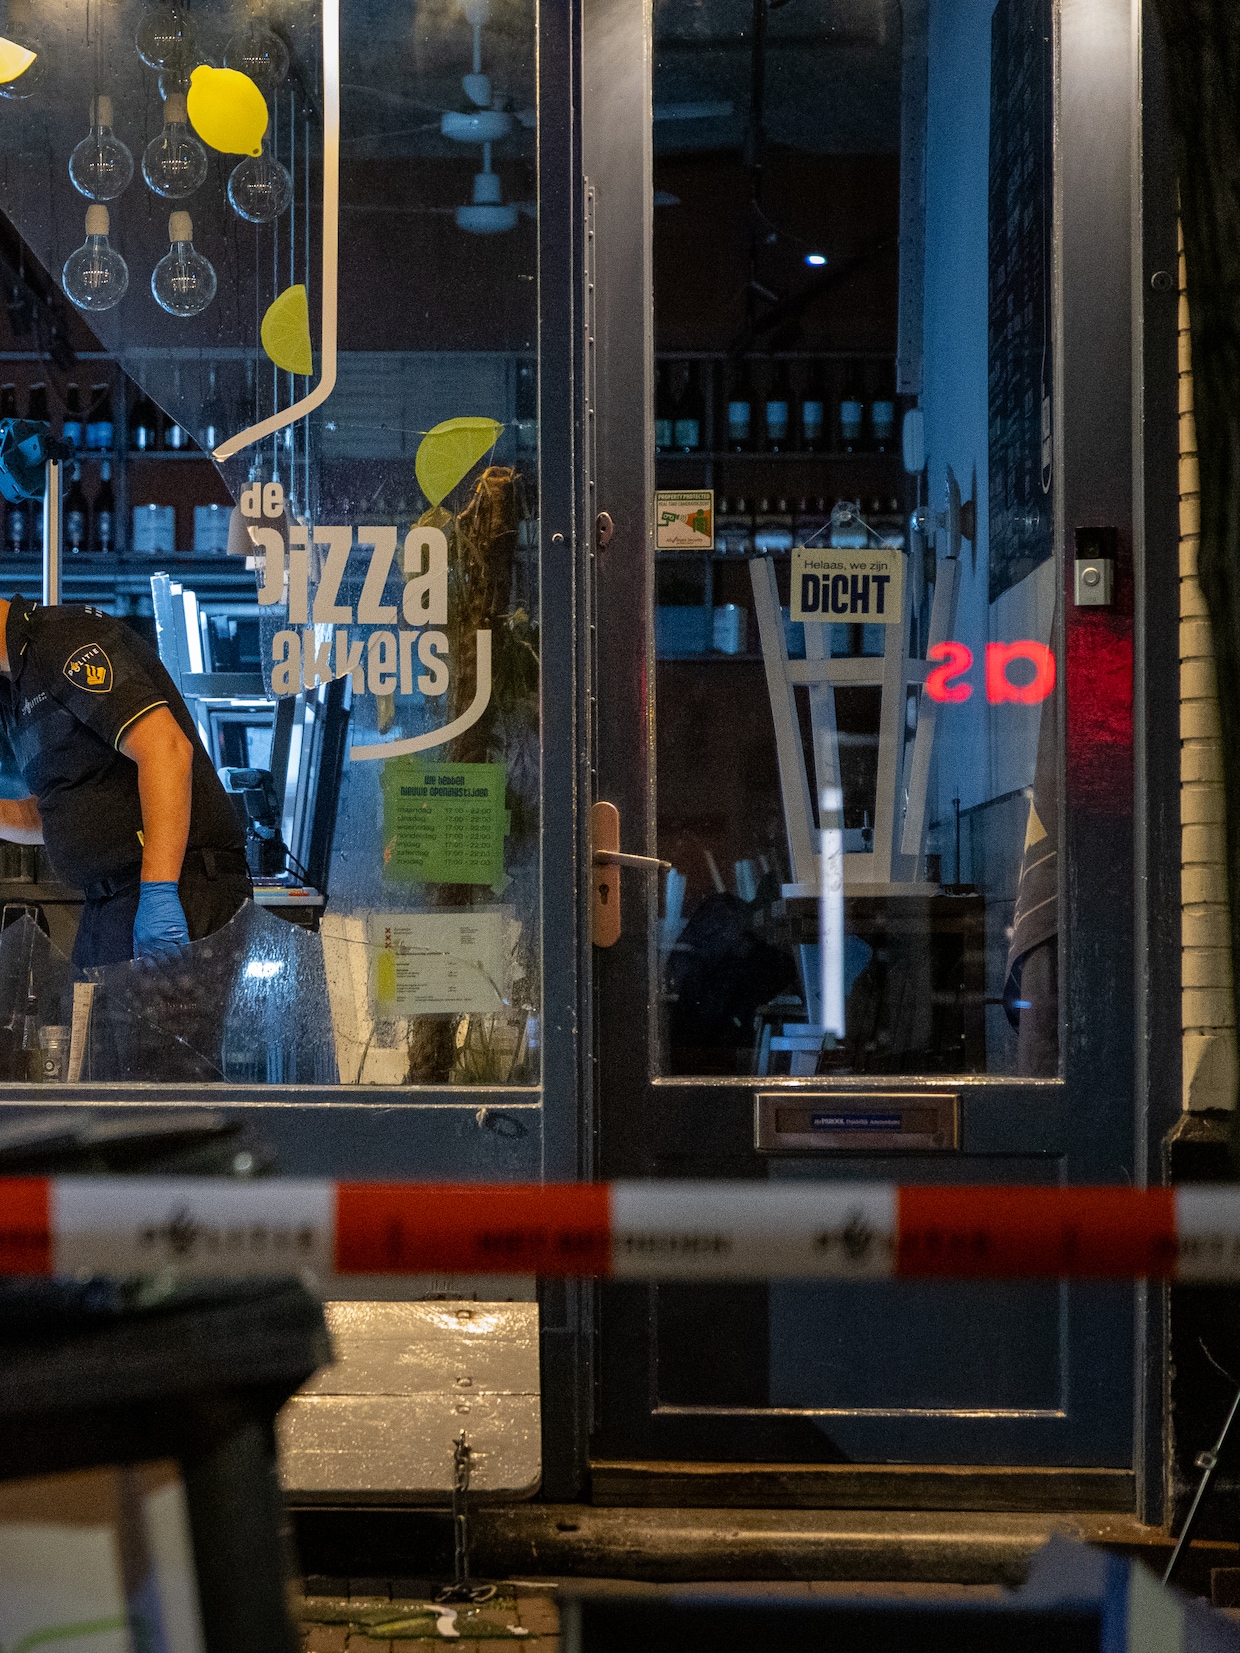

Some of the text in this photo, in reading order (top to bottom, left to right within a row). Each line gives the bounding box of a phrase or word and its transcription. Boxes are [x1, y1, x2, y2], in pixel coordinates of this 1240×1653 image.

[240, 482, 284, 518] de
[804, 561, 847, 570] Helaas,
[869, 562, 888, 572] zijn
[67, 648, 100, 677] POLITIE
